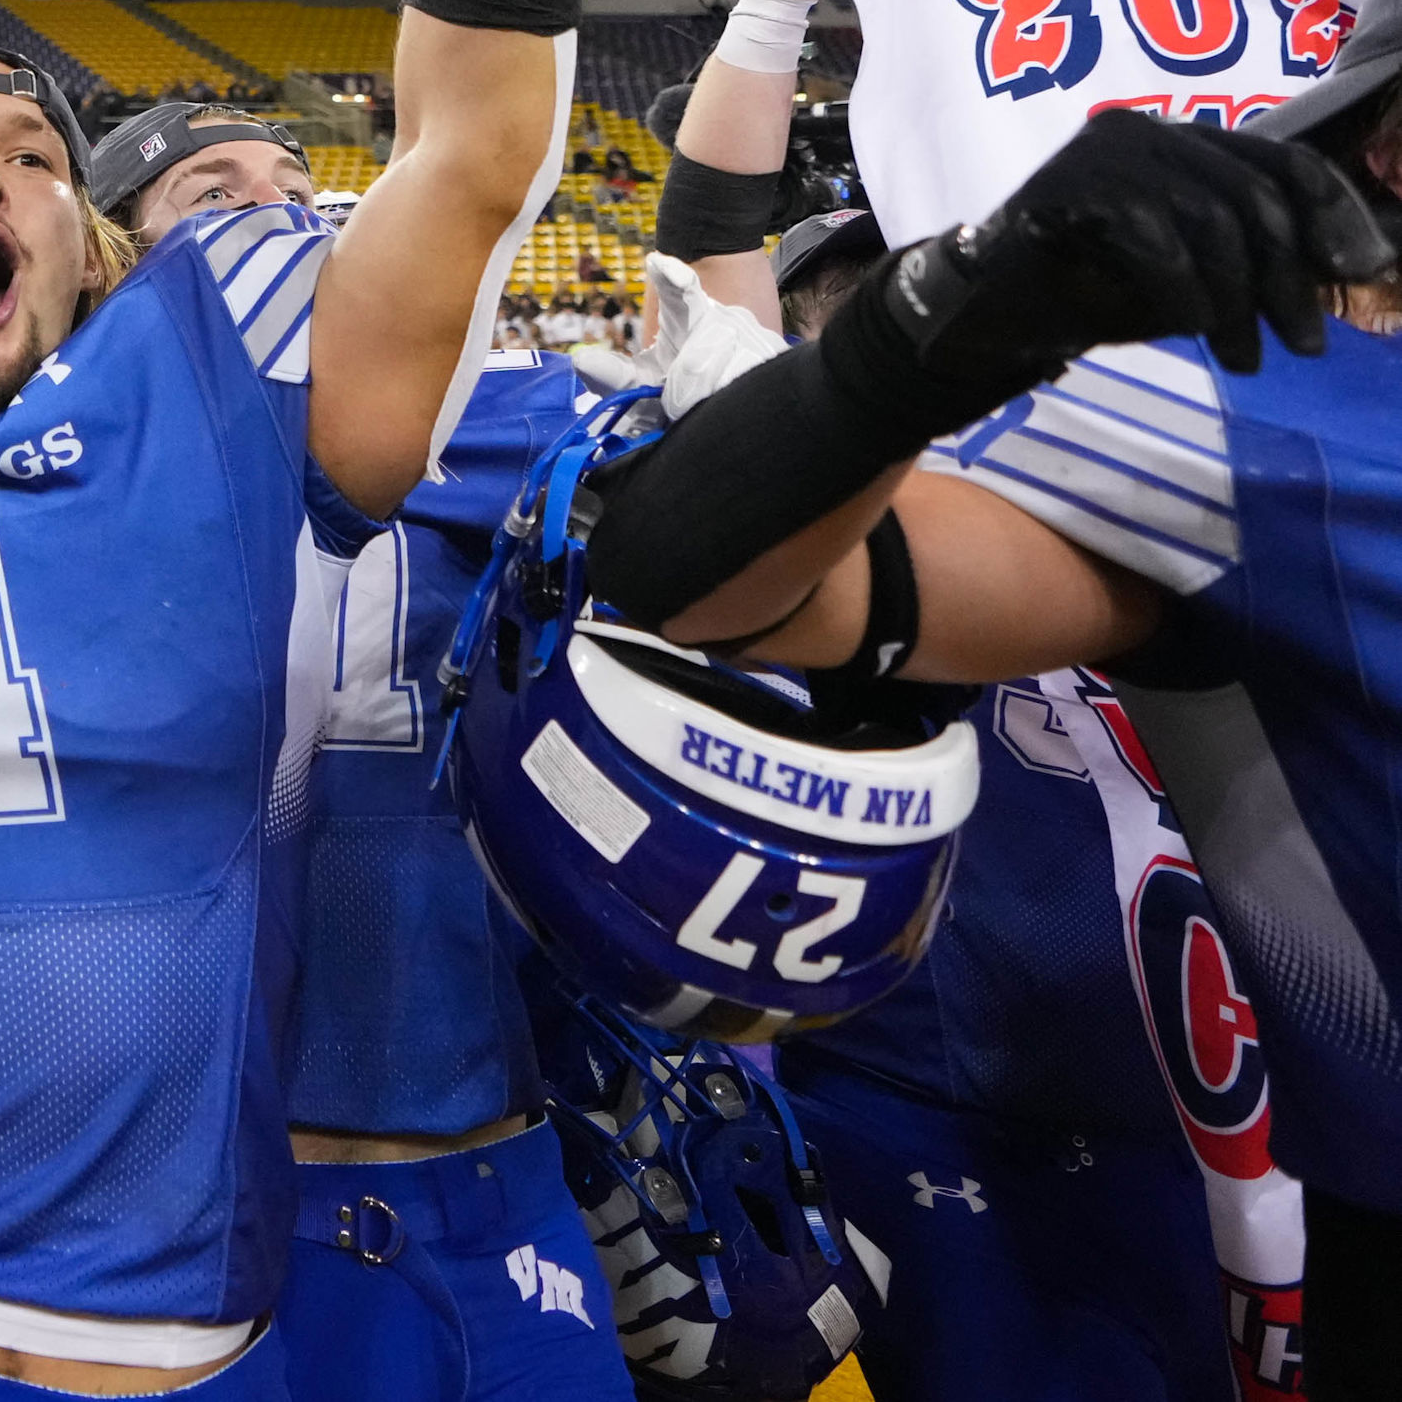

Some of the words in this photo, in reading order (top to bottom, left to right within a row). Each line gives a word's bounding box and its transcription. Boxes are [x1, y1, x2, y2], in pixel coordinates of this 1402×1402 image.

[680, 722, 851, 818] METER
[861, 786, 932, 827] VAN
[676, 851, 867, 985] 27
